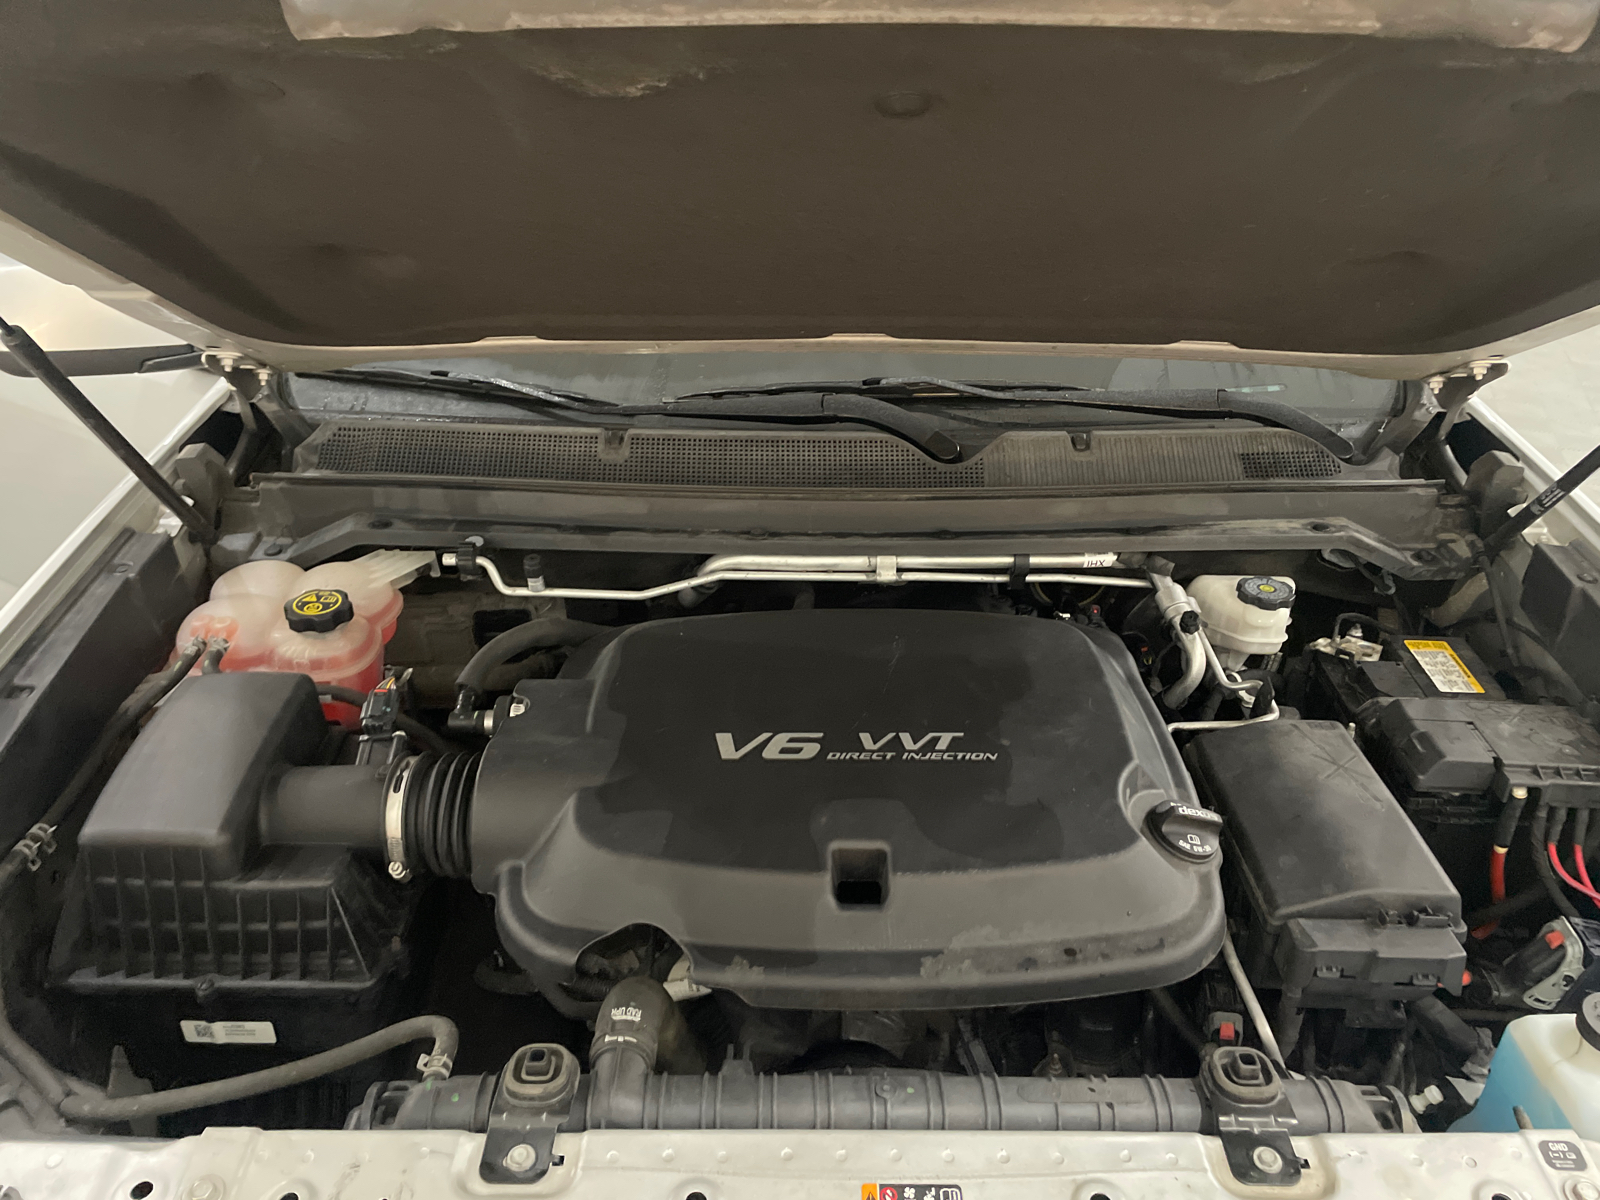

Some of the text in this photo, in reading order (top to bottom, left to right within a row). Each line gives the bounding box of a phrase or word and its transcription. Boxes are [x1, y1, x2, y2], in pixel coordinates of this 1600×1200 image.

[715, 732, 964, 760] V6 VVT
[826, 752, 998, 760] DIRECT INJECTION
[1548, 1142, 1568, 1151] GND
